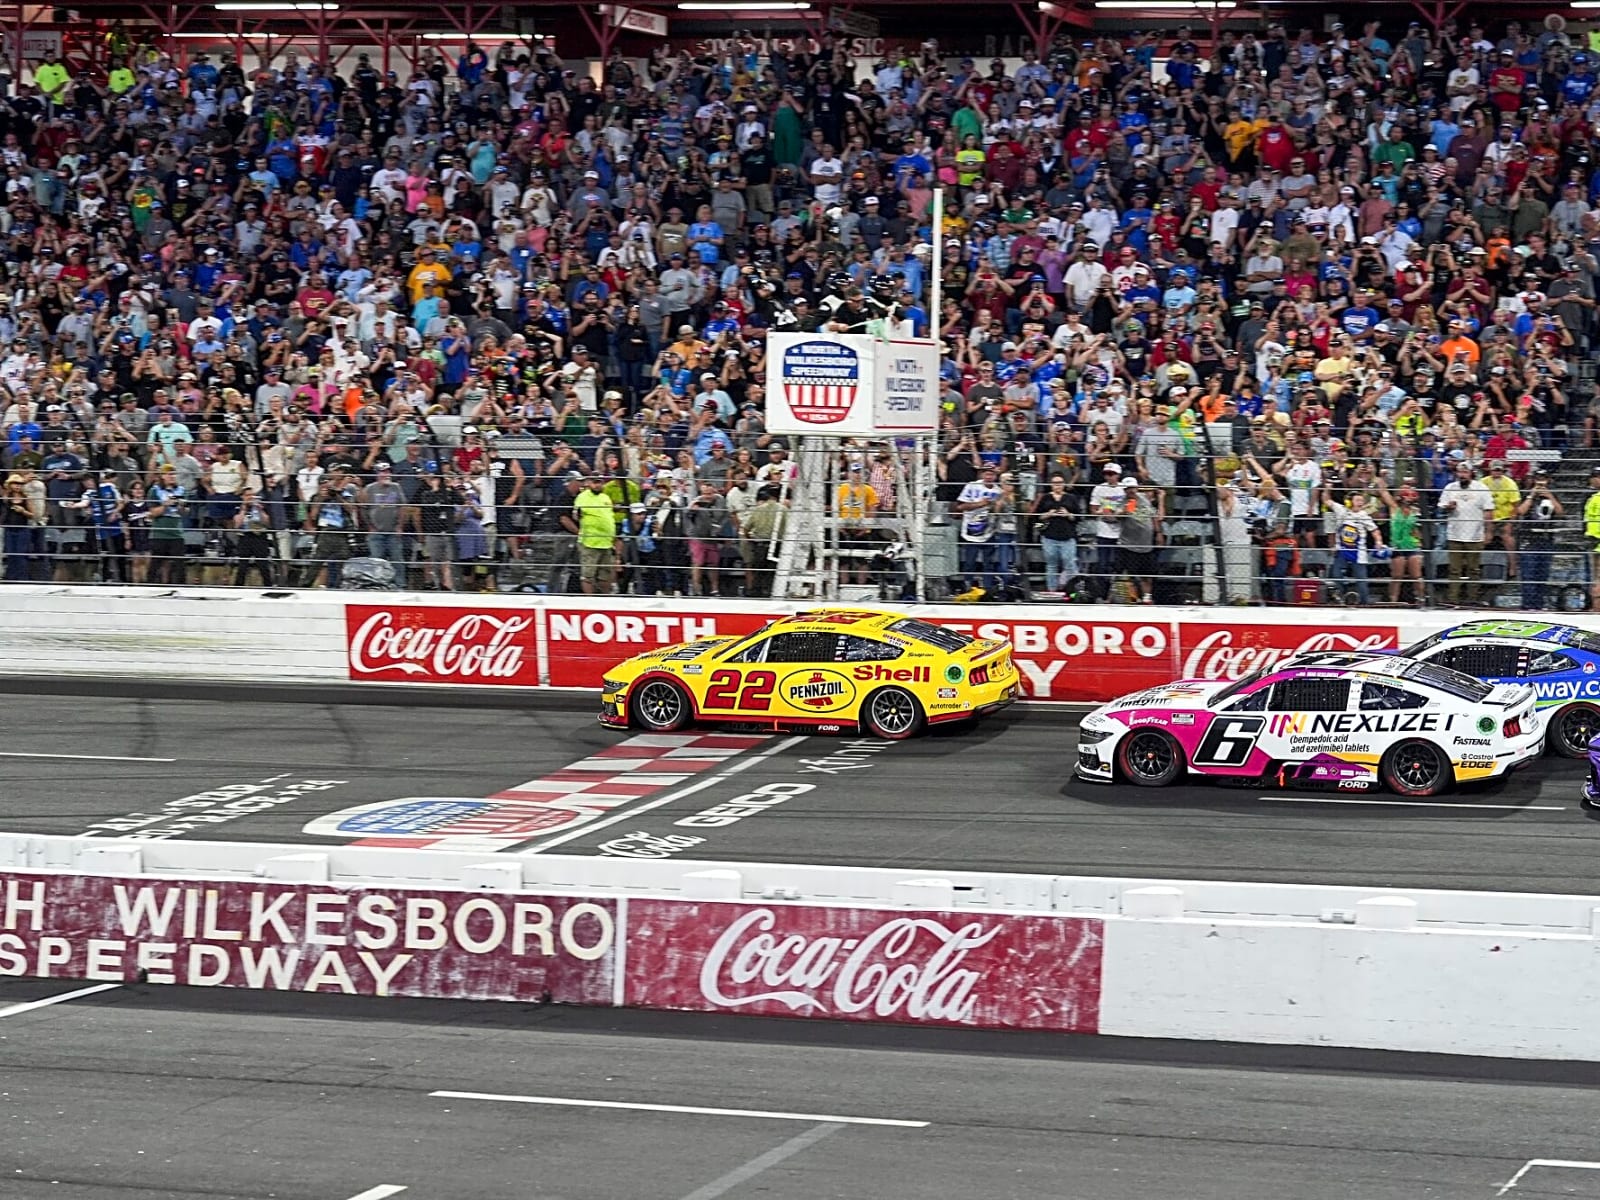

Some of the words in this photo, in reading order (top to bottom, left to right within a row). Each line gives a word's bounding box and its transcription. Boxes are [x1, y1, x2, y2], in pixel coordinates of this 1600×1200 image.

[551, 613, 716, 644] NORTH
[349, 611, 532, 678] Coca-Cola
[853, 665, 930, 682] Shell
[703, 669, 777, 711] 22
[790, 682, 844, 699] PENNZOIL
[1194, 715, 1266, 767] 6
[1290, 744, 1305, 753] and
[1345, 743, 1370, 753] tablets
[1333, 734, 1349, 743] acid
[1453, 735, 1492, 746] FASTENAL
[1460, 761, 1493, 769] EDGE
[1338, 781, 1369, 789] FORD
[673, 782, 817, 827] GEICO
[114, 884, 614, 962] WILKESBORO
[0, 932, 413, 997] SPEEDWAY
[699, 908, 1003, 1022] Coca-Cola
